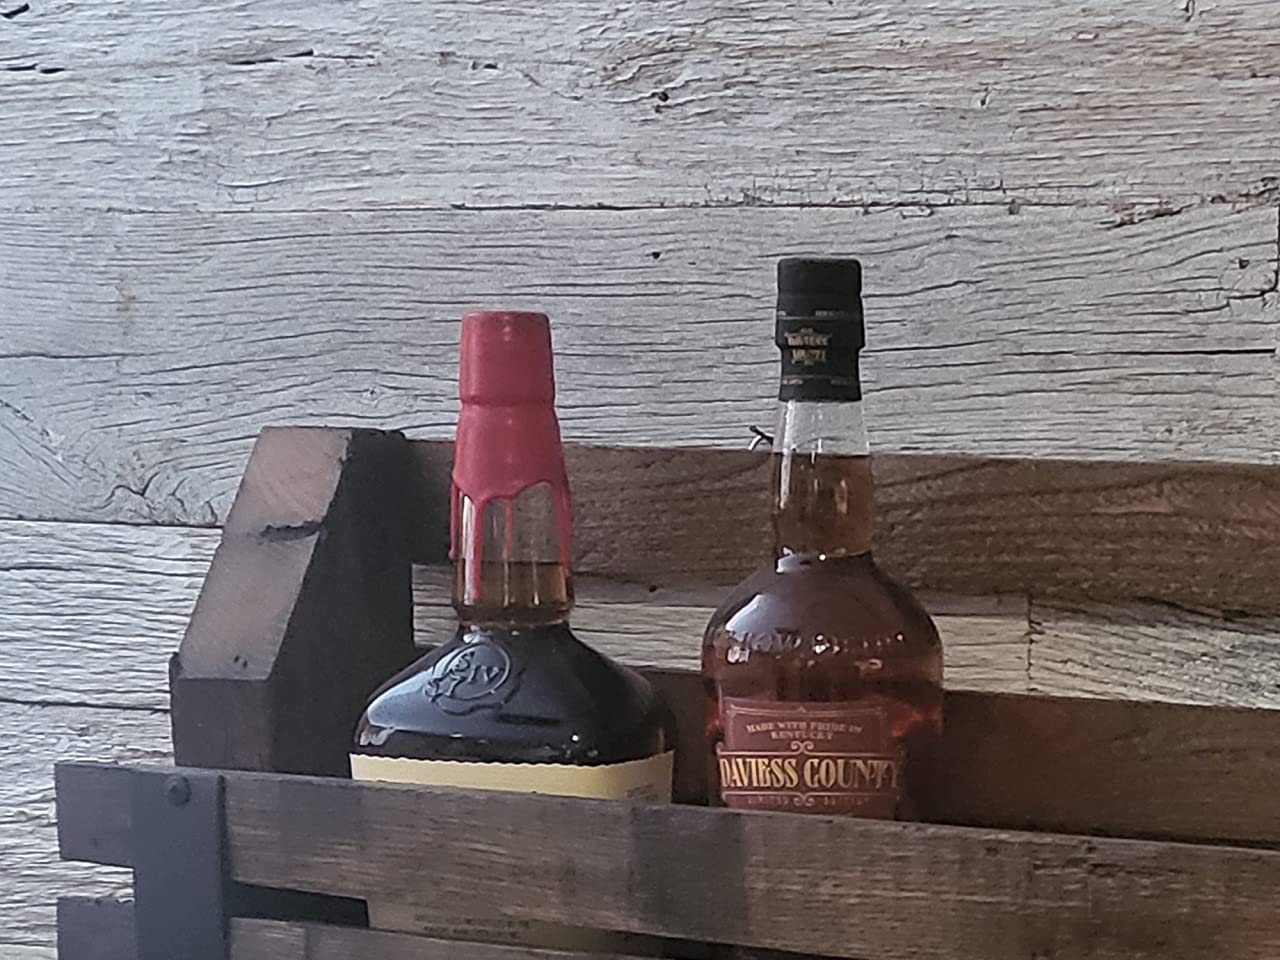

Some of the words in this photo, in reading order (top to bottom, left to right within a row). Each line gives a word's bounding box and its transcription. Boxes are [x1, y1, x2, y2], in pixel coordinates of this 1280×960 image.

[746, 722, 774, 733] MADE
[777, 721, 807, 730] WITH
[810, 721, 845, 732] PRIDE
[771, 731, 833, 740] KENTUCKY
[719, 758, 799, 788] DAVIESS
